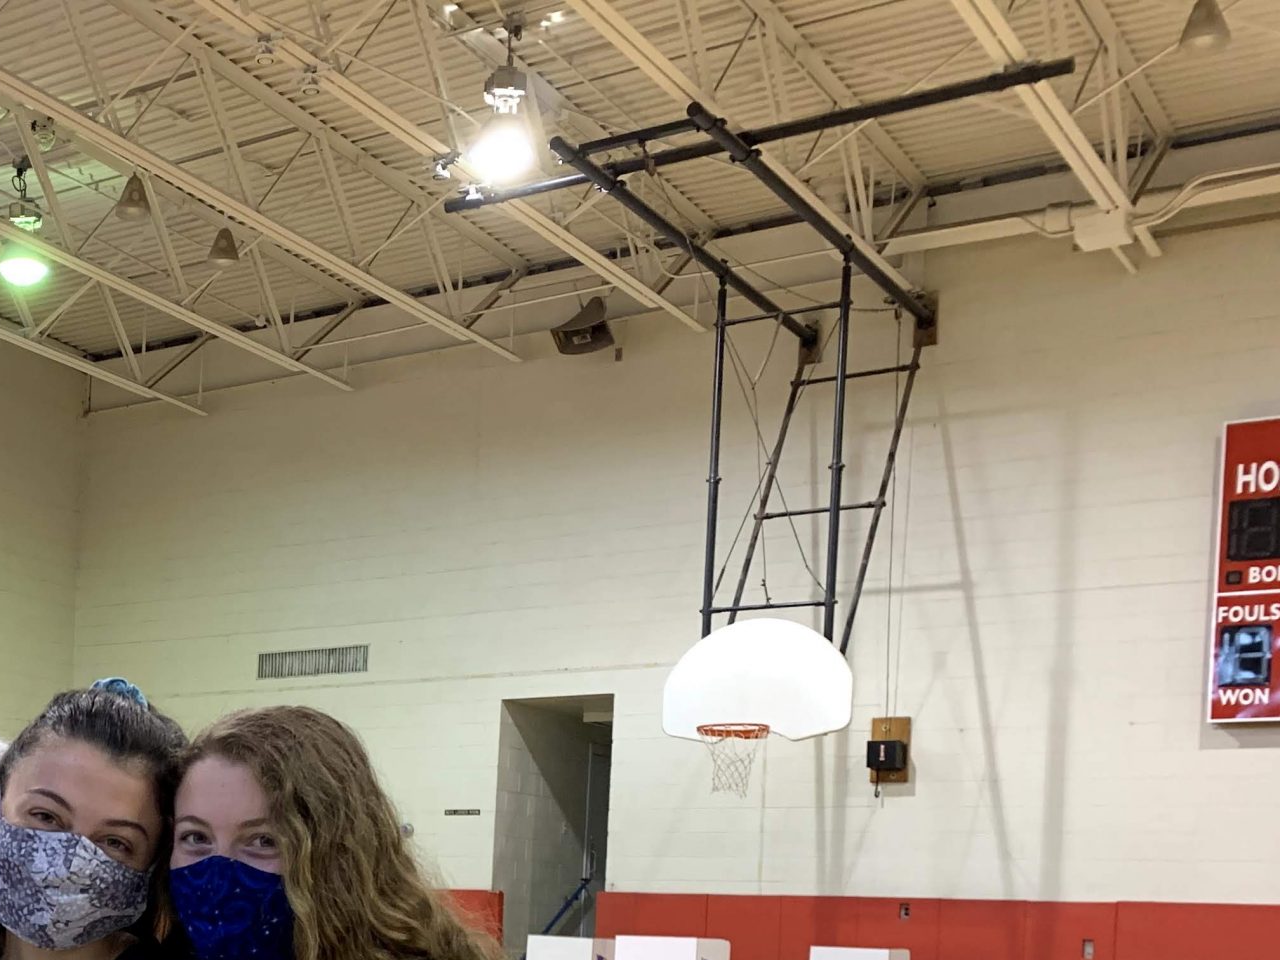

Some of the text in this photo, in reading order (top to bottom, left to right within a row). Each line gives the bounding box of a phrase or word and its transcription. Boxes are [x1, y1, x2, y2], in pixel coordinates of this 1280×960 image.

[1236, 460, 1280, 494] HO
[1248, 565, 1280, 583] BO
[1218, 602, 1280, 622] FOULS
[1219, 687, 1270, 705] WON
